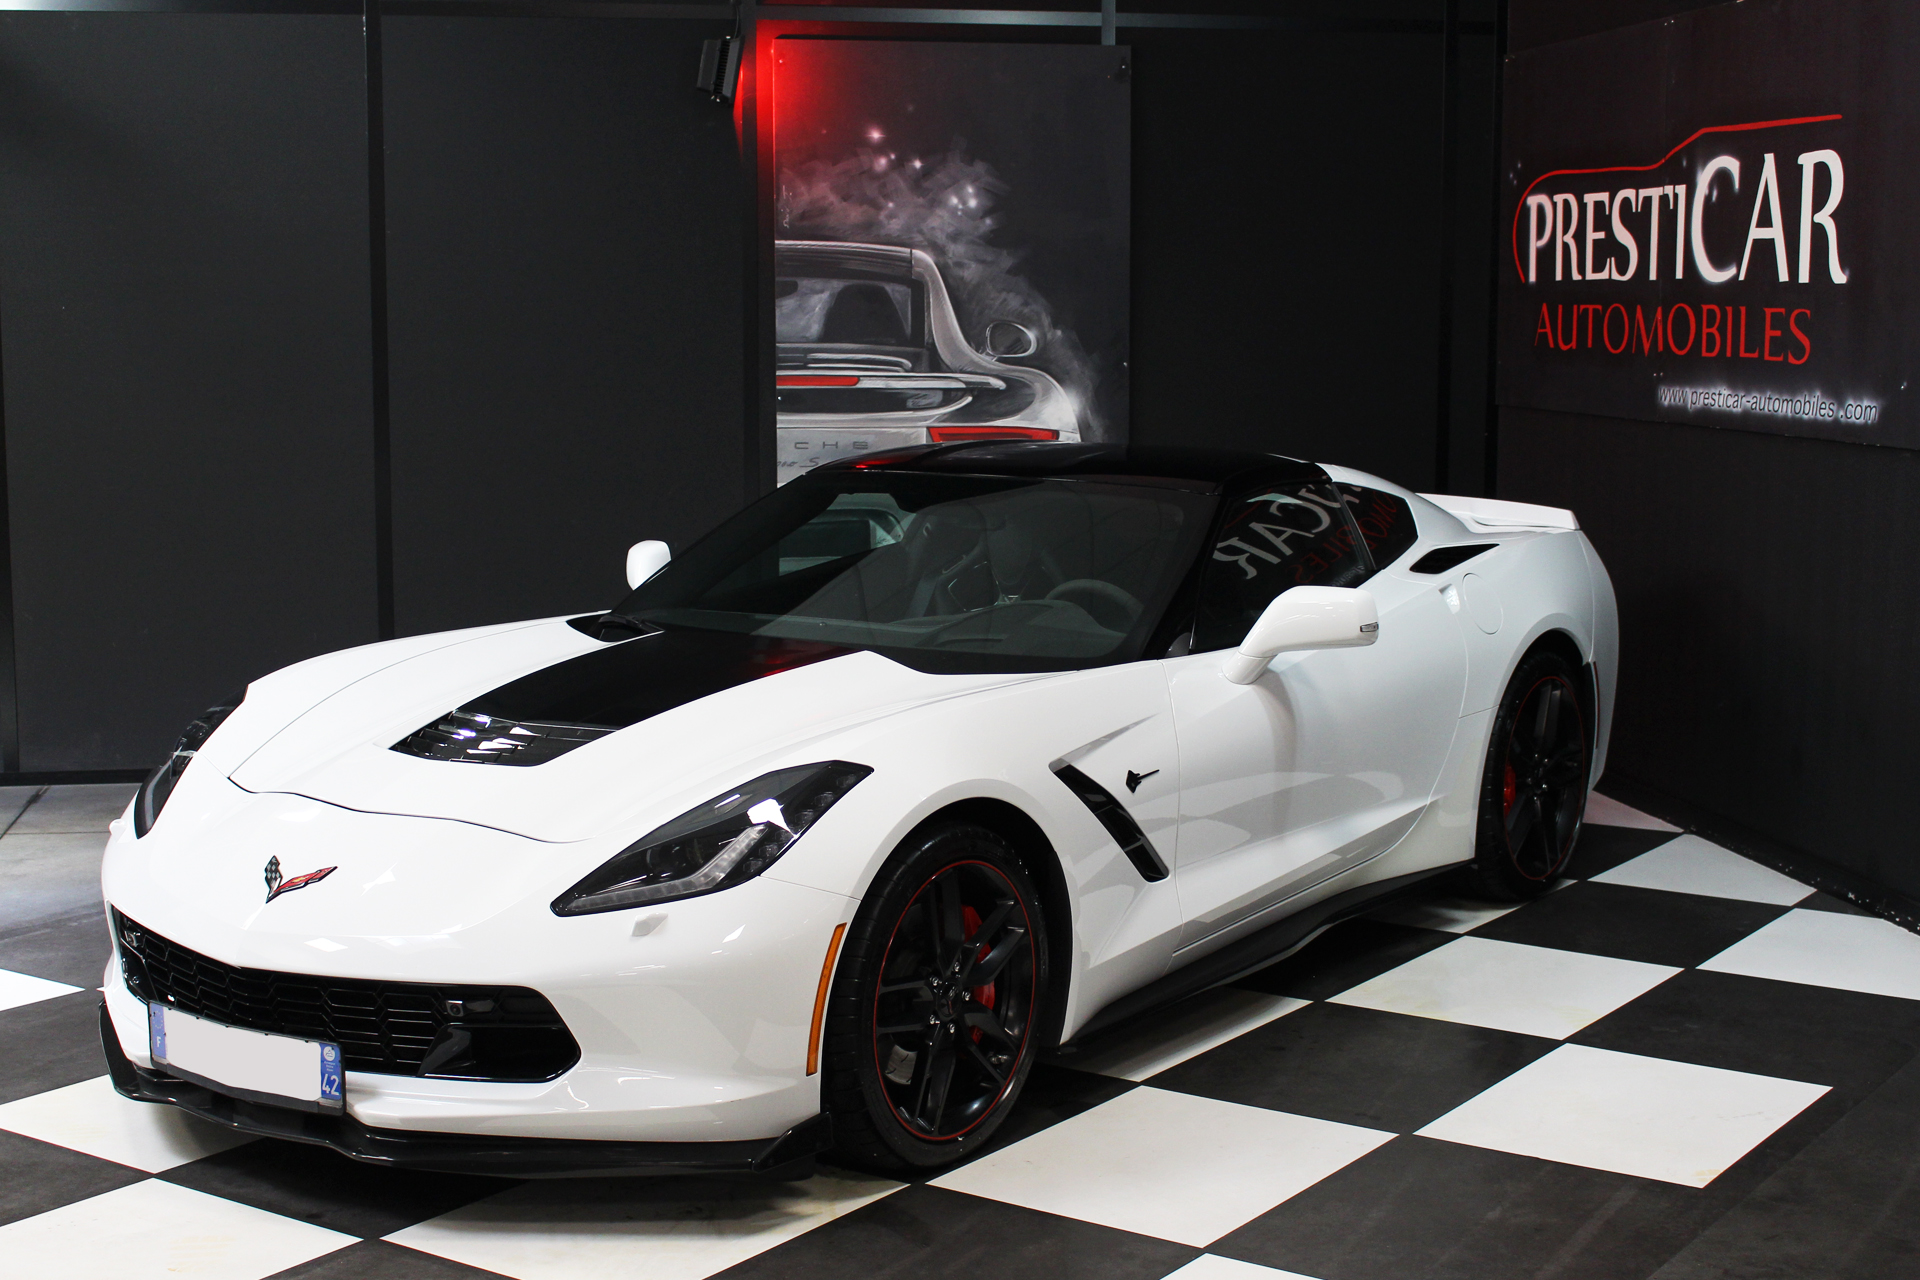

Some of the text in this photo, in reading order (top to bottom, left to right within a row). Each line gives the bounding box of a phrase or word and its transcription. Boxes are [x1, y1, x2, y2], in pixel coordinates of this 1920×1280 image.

[1526, 148, 1849, 285] PRESTICAR
[1534, 302, 1812, 365] AUTOMOBILES
[321, 1073, 340, 1096] 42
